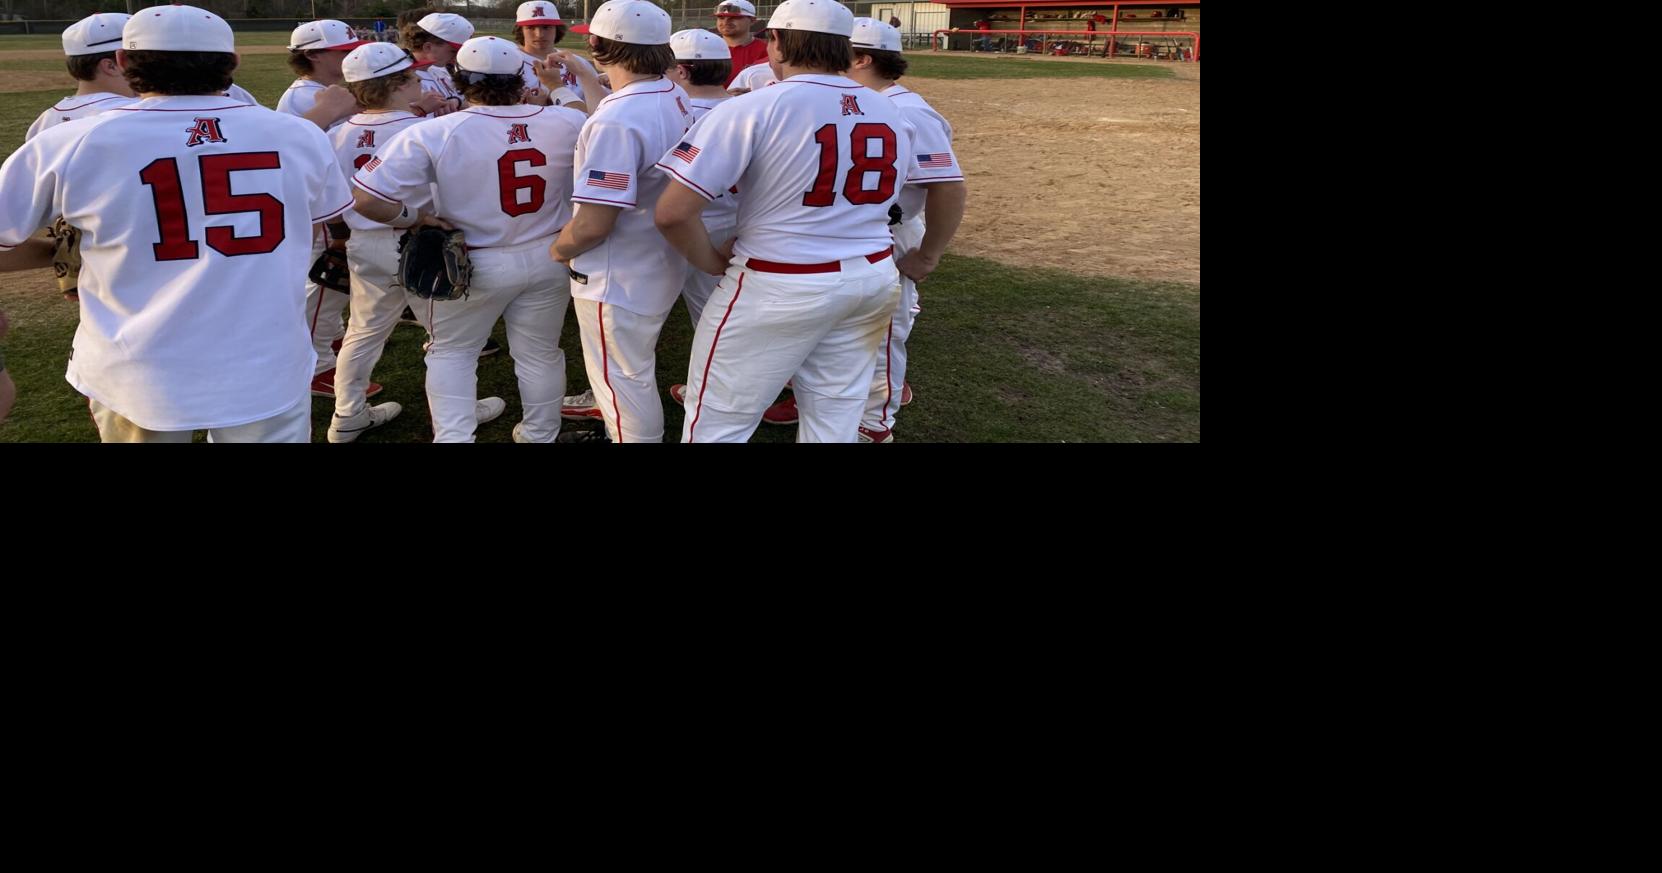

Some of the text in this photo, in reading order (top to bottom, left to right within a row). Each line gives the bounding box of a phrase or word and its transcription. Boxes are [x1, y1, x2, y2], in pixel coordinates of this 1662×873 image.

[840, 93, 865, 116] A
[186, 117, 227, 147] A
[356, 129, 375, 148] A
[506, 123, 532, 145] A
[802, 123, 898, 207] 18
[497, 148, 546, 217] 6
[139, 151, 285, 261] 15
